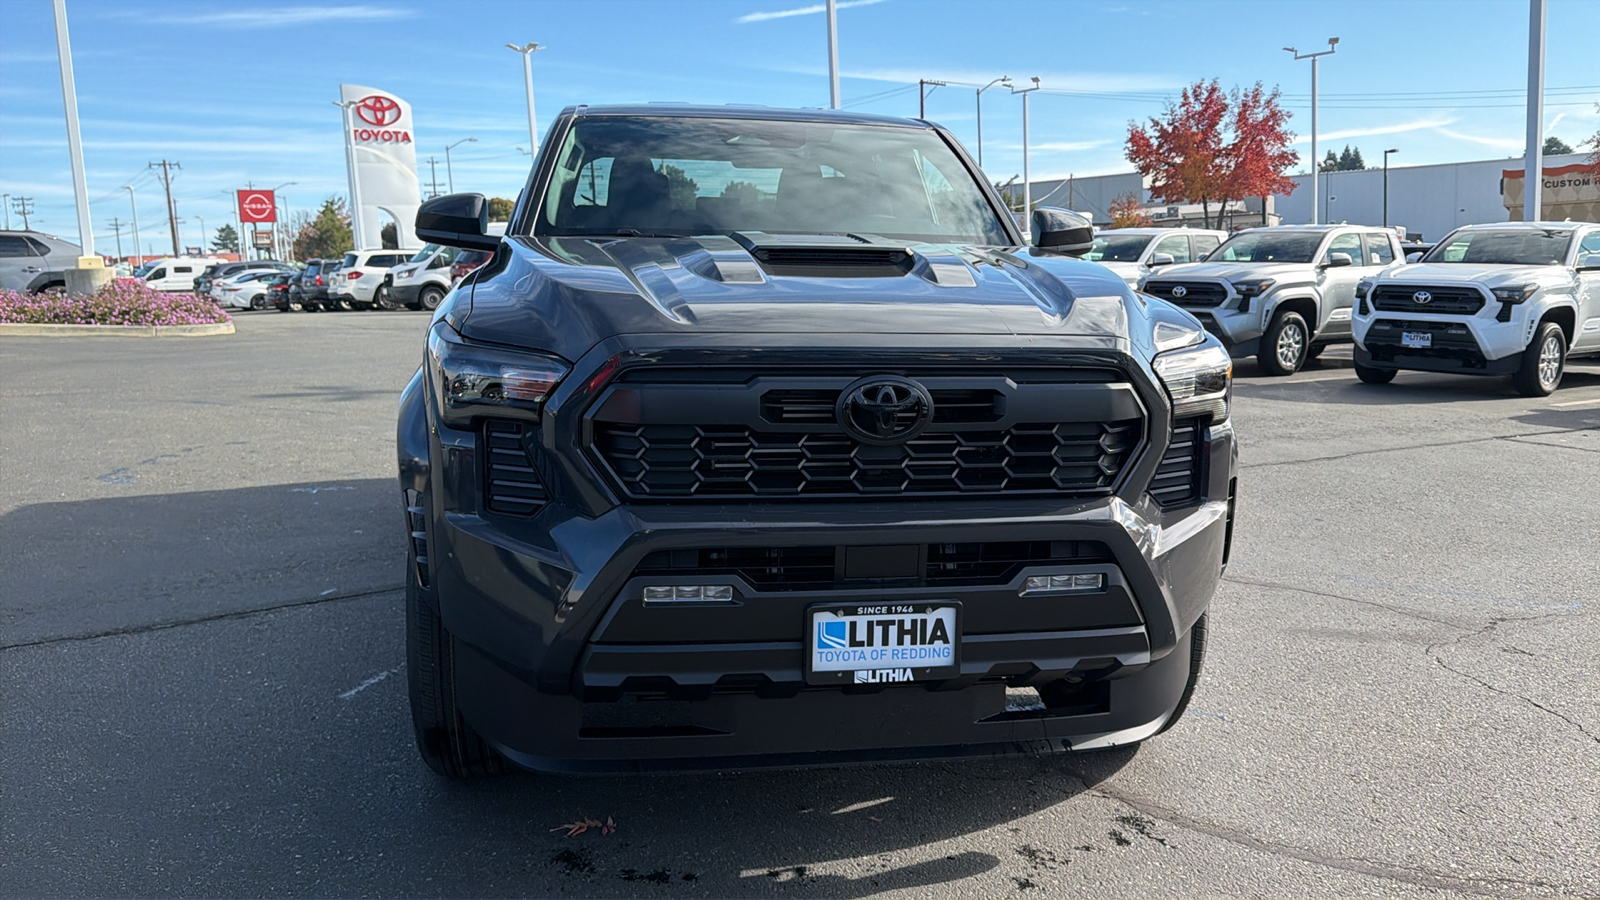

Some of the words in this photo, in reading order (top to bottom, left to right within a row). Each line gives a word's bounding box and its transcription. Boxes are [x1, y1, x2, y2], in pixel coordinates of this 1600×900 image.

[354, 129, 412, 143] TOYOTA
[1544, 178, 1591, 189] CUSTOM
[857, 607, 888, 615] SINCE
[849, 618, 950, 647] LITHIA
[817, 650, 867, 663] TOYOTA
[870, 649, 888, 660] OF
[891, 647, 950, 660] REDDING
[867, 668, 914, 683] LITHIA
